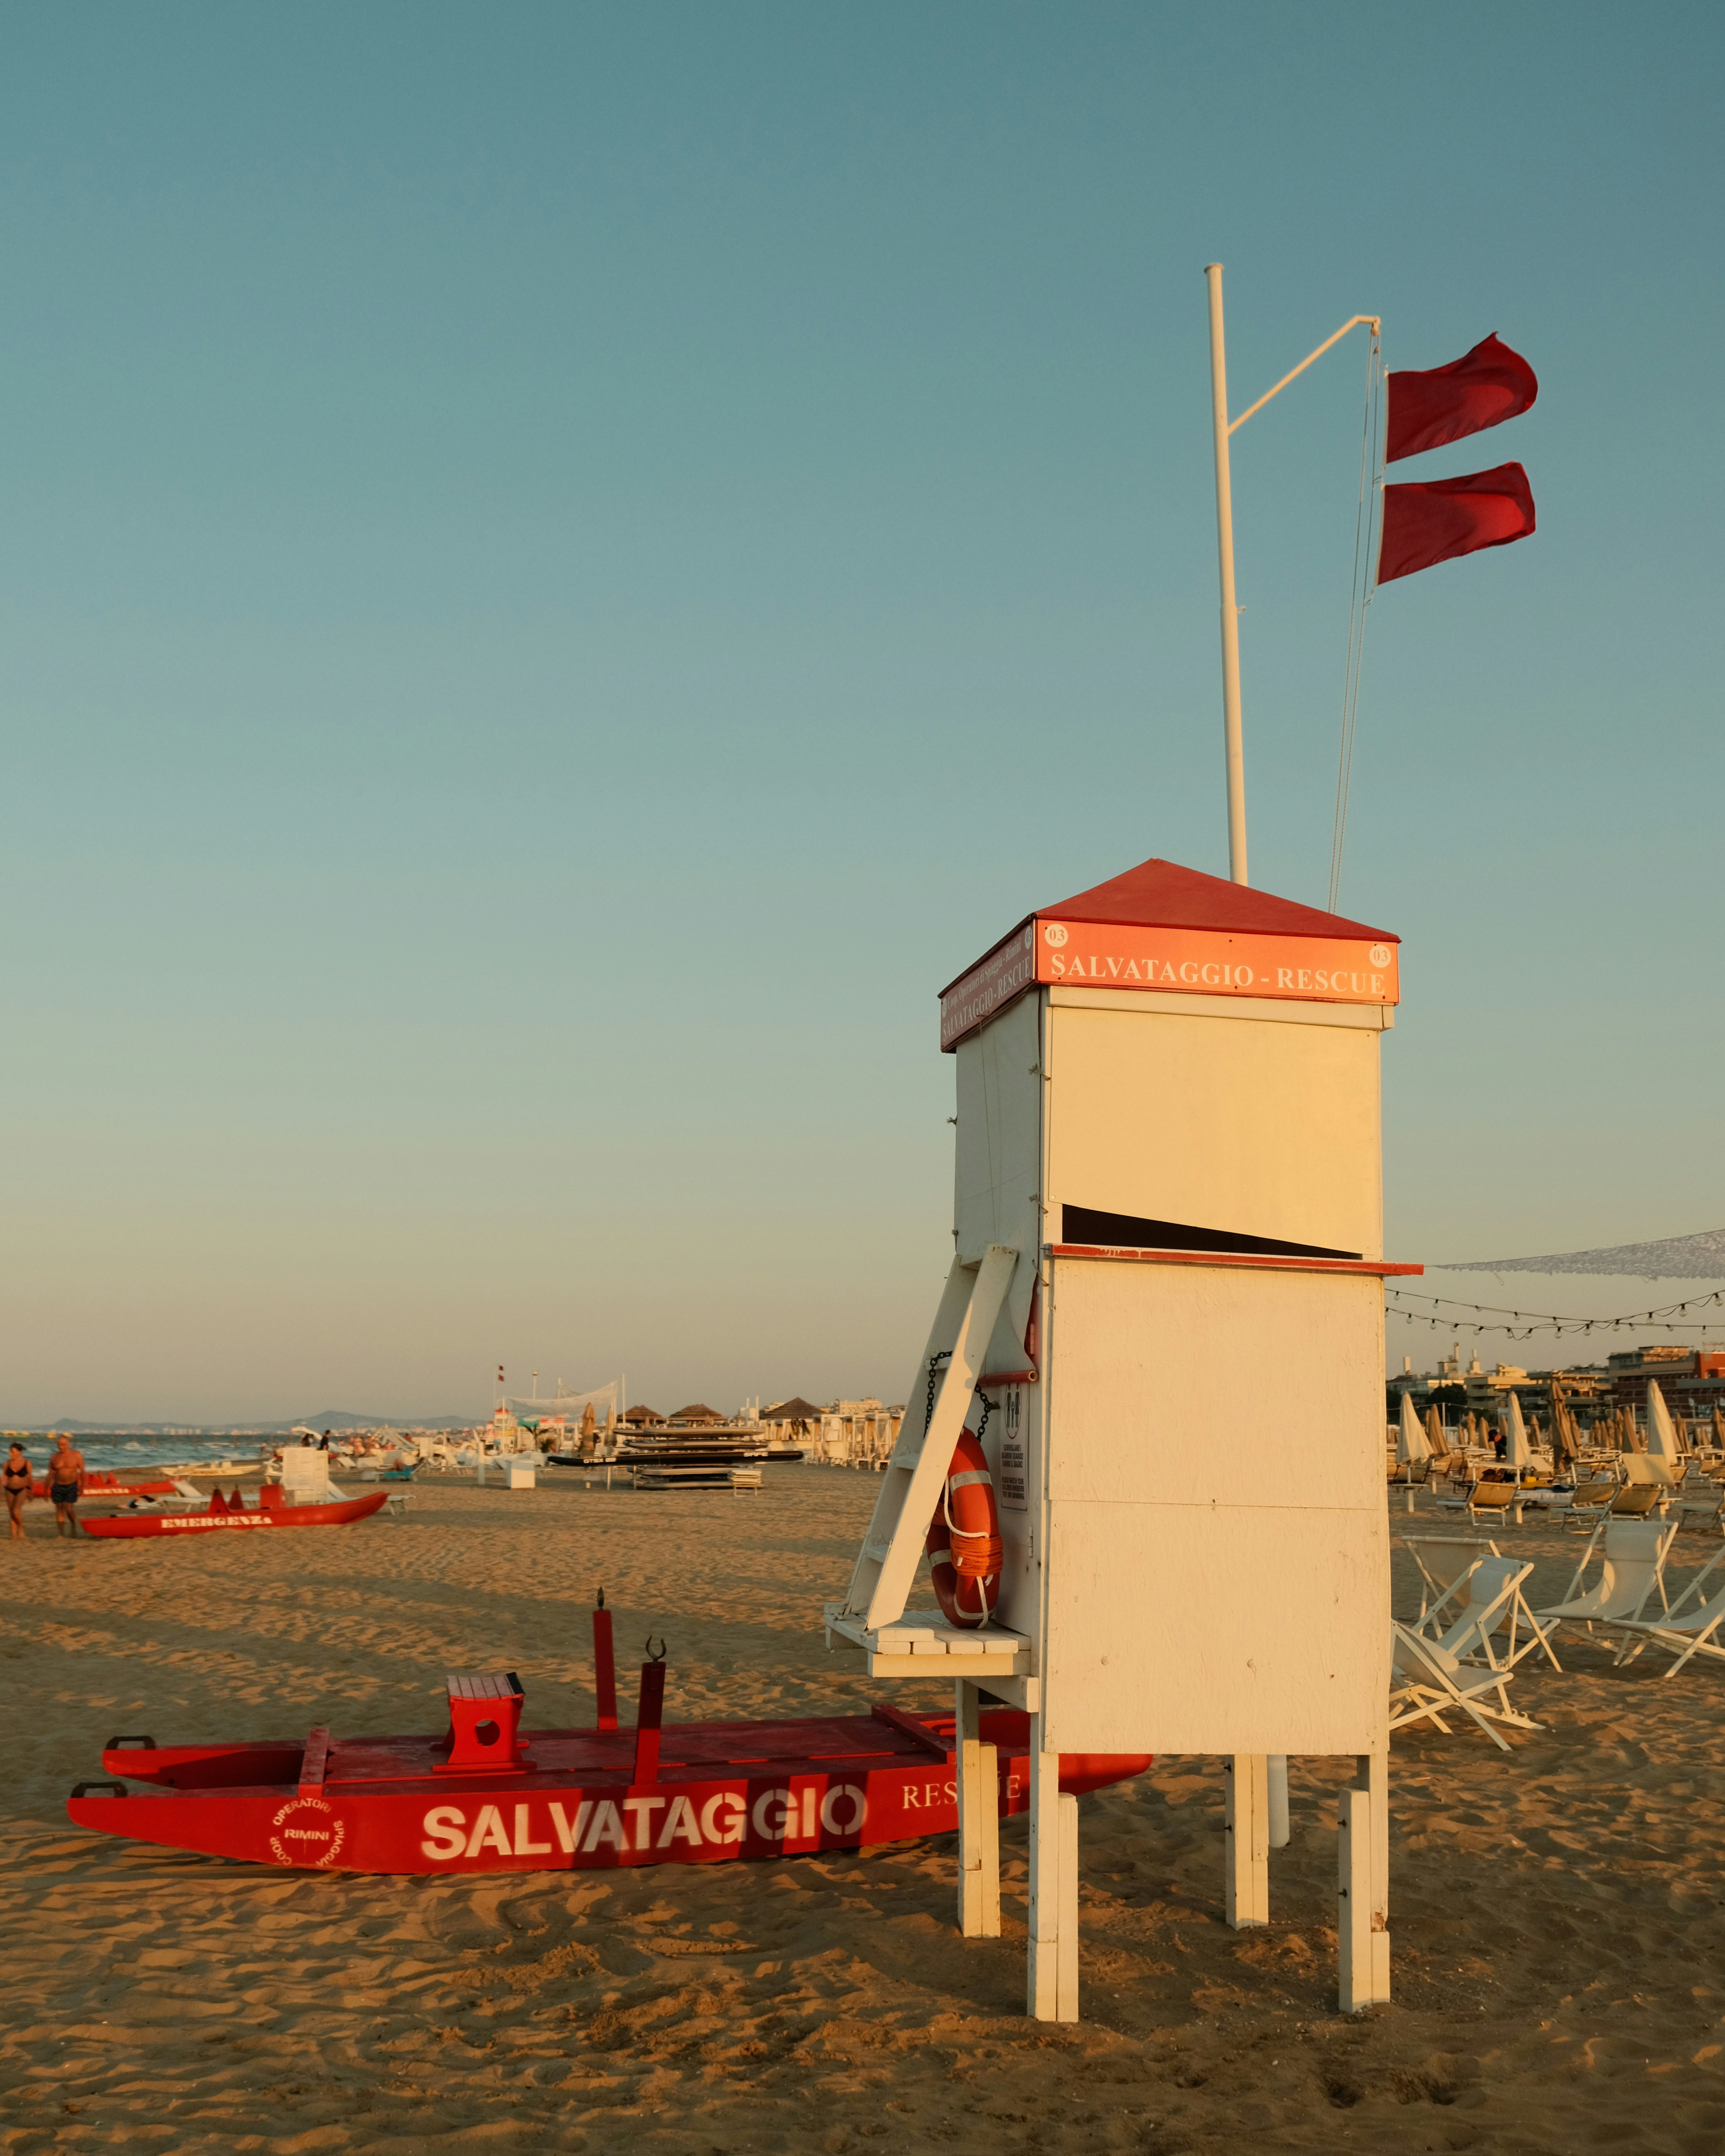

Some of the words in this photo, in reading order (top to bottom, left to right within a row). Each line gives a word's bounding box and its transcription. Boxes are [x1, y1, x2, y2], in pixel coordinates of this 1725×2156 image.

[1049, 929, 1065, 941] 03
[959, 976, 979, 1001] Operatori
[980, 971, 984, 986] di
[985, 956, 1002, 982] Spiaggia
[1006, 937, 1021, 962] Rimini
[1373, 949, 1388, 961] 03
[1052, 954, 1254, 986] SALVATAGGIO
[1276, 968, 1385, 994] RESCUE
[943, 988, 993, 1042] SALVATAGGIO
[998, 956, 1030, 999] RESCUE
[273, 1798, 332, 1825] OPERATORI
[421, 1784, 867, 1860] SALVATAGGIO
[284, 1829, 329, 1840] RIMINI
